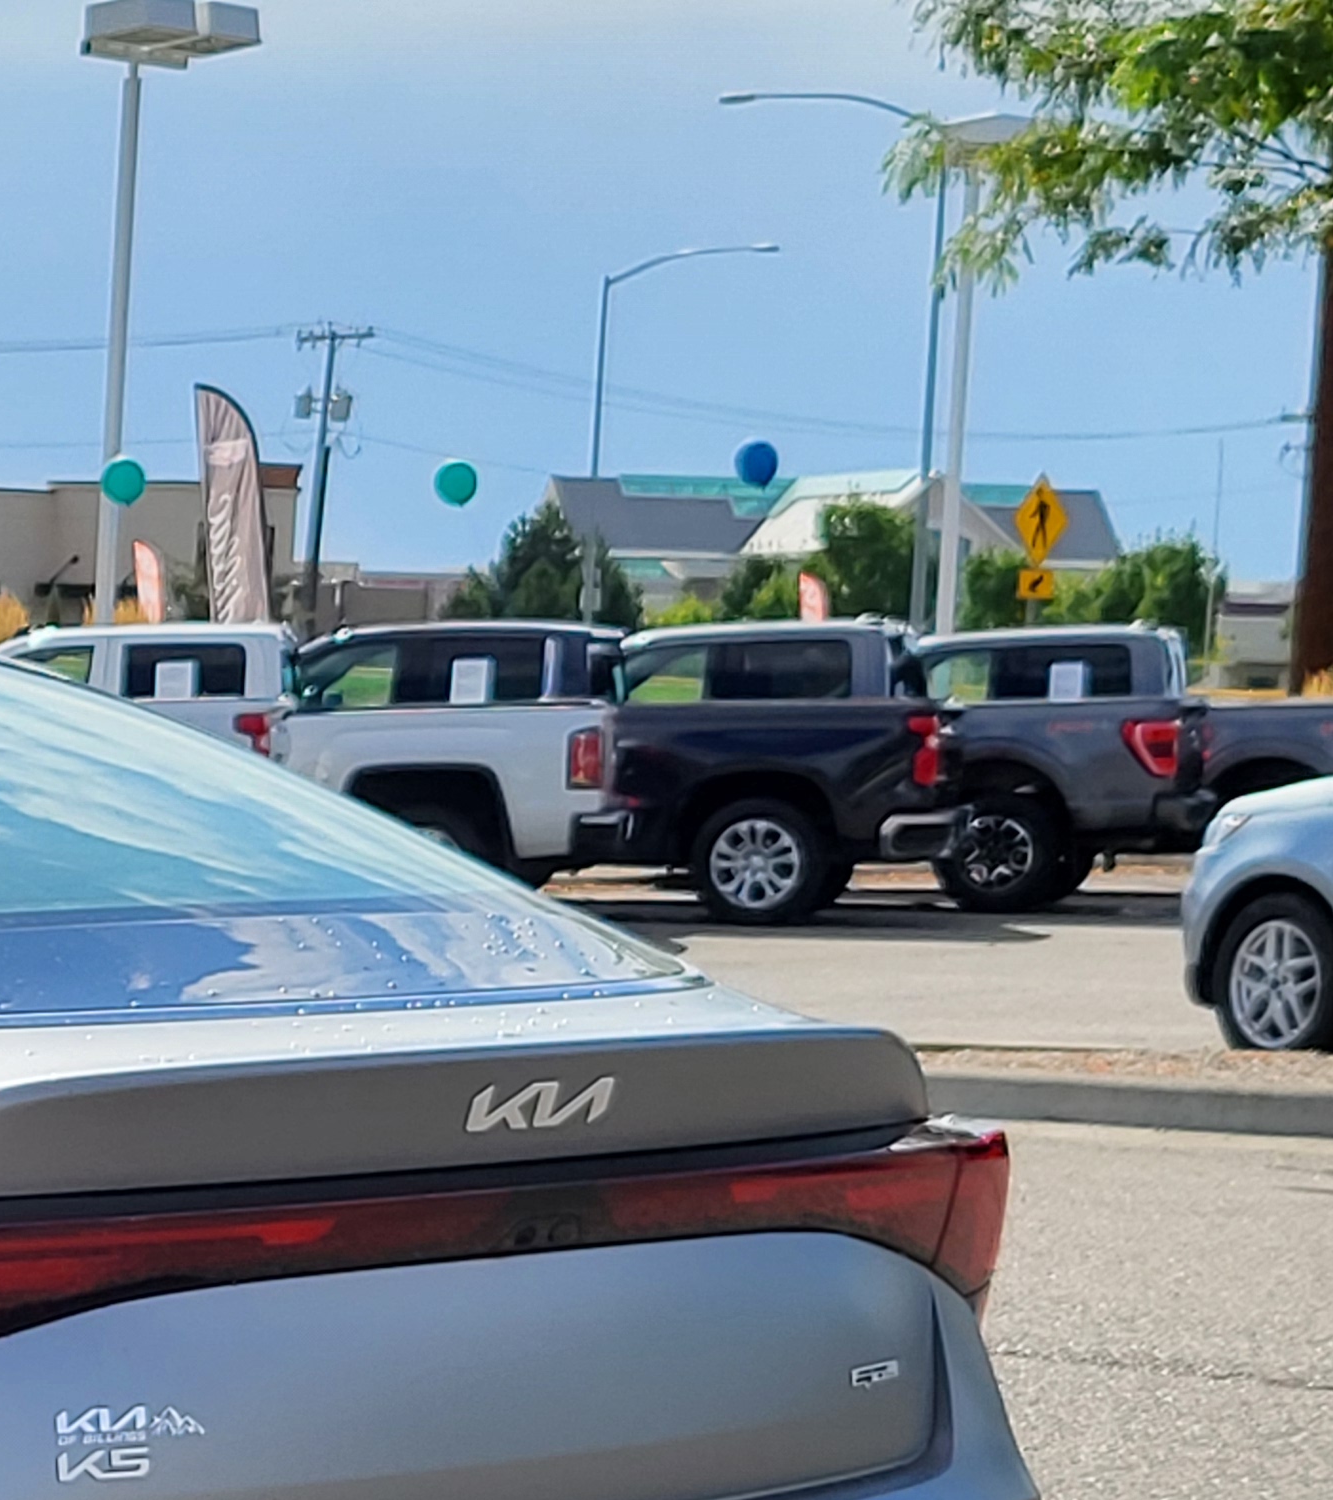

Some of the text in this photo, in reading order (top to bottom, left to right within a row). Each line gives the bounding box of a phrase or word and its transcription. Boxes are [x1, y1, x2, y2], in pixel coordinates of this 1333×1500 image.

[465, 1076, 615, 1133] KIA
[55, 1405, 147, 1434] KIA
[83, 1431, 147, 1445] BILLINGS
[57, 1447, 150, 1482] K5
